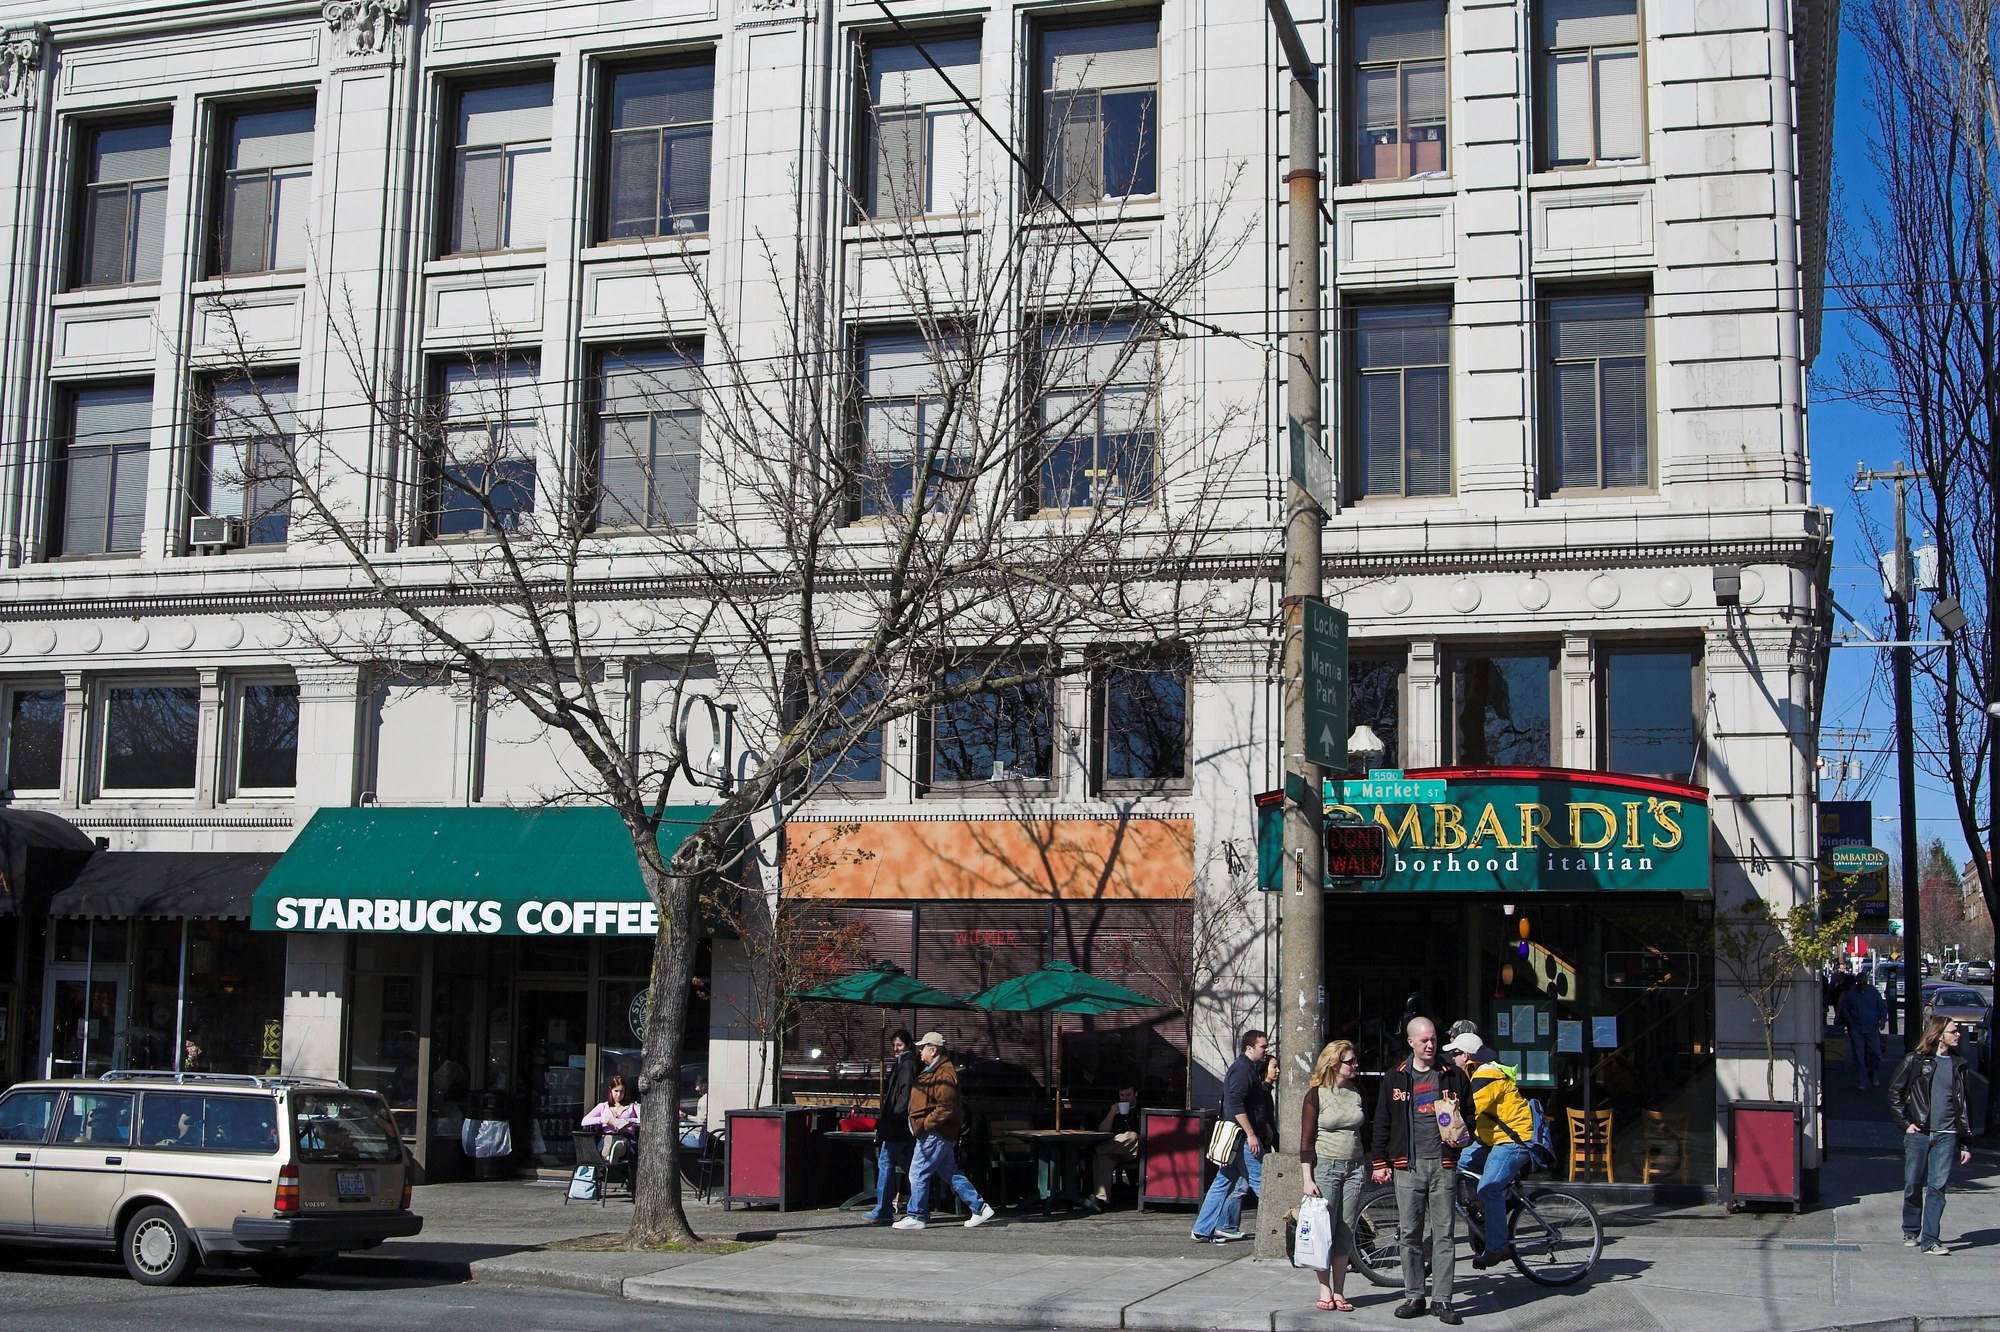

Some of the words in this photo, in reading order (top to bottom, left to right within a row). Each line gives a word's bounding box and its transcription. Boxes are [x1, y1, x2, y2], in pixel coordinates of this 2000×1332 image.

[1313, 609, 1339, 639] Locks
[1311, 650, 1342, 681] Marina
[1316, 679, 1337, 706] Park
[1374, 772, 1398, 780] 5500
[1362, 783, 1420, 798] Market
[1427, 789, 1440, 797] ST
[1332, 854, 1381, 874] WALK
[1547, 852, 1653, 871] italian
[275, 897, 502, 933] STARBUCKS
[516, 900, 660, 934] COFFEE
